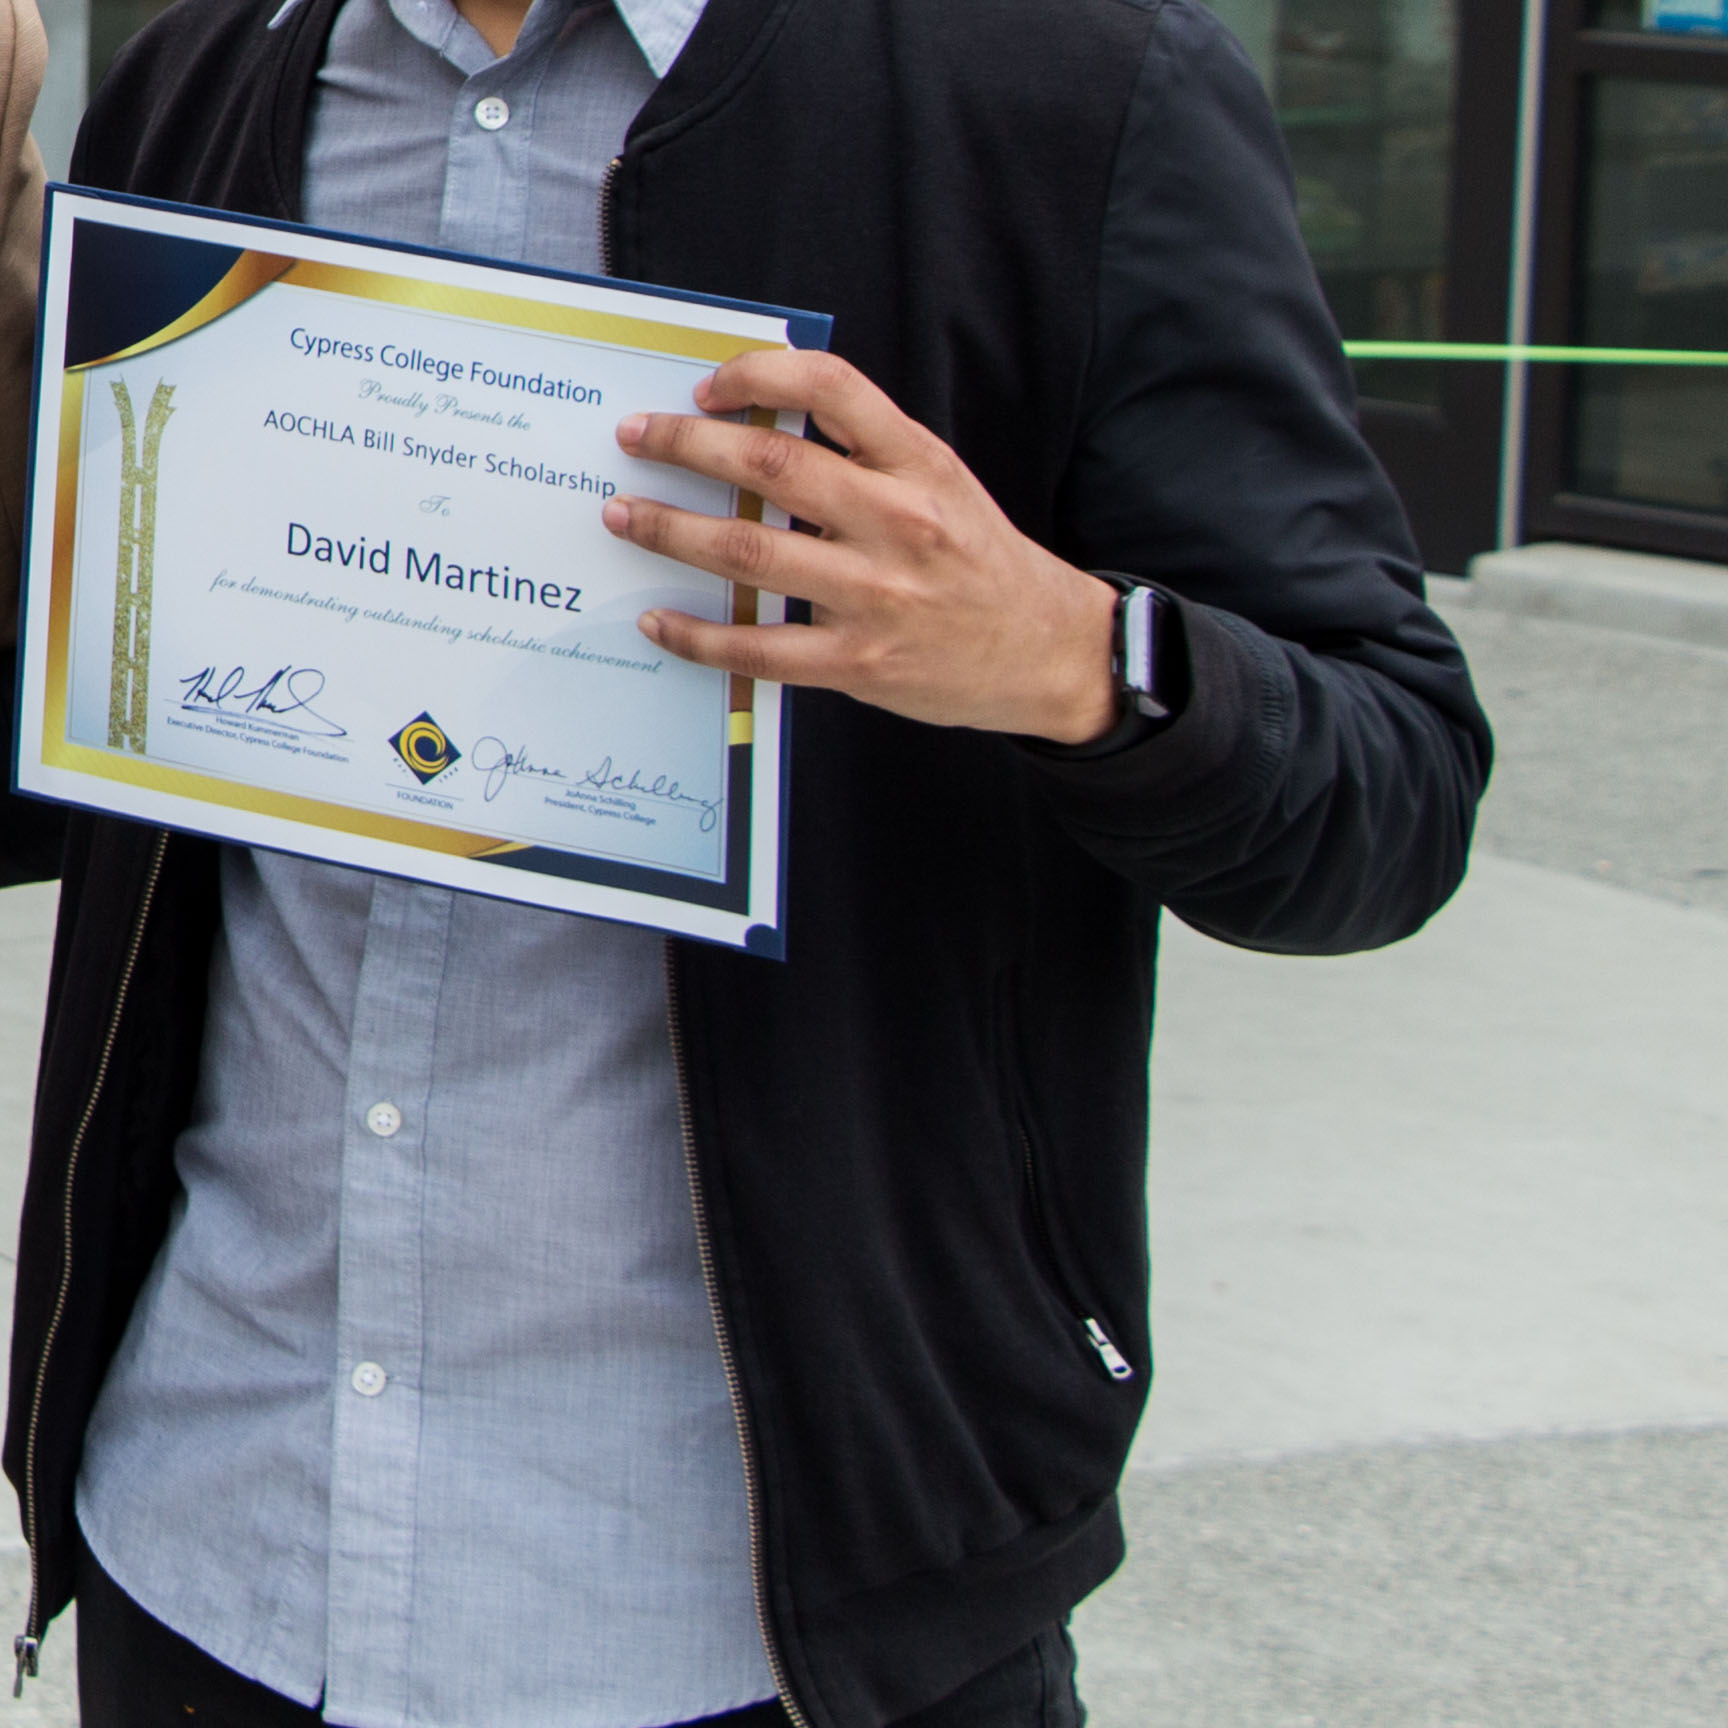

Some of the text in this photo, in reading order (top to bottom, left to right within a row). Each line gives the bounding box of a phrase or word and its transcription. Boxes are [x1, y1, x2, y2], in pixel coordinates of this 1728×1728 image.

[290, 327, 603, 406] Cypress College Foundation
[358, 378, 531, 432] Proudly Presents the
[263, 409, 617, 499] AOCHLA Bill Snyder Scholarship
[418, 494, 452, 518] To
[286, 522, 582, 613] David Martinez
[209, 569, 664, 675] for demonstrating outstanding scholastic achievement
[166, 715, 204, 732] Executive
[239, 732, 270, 748] Cypress
[272, 739, 301, 755] College
[302, 745, 350, 764] Foundation
[397, 791, 454, 810] FOUNDATION
